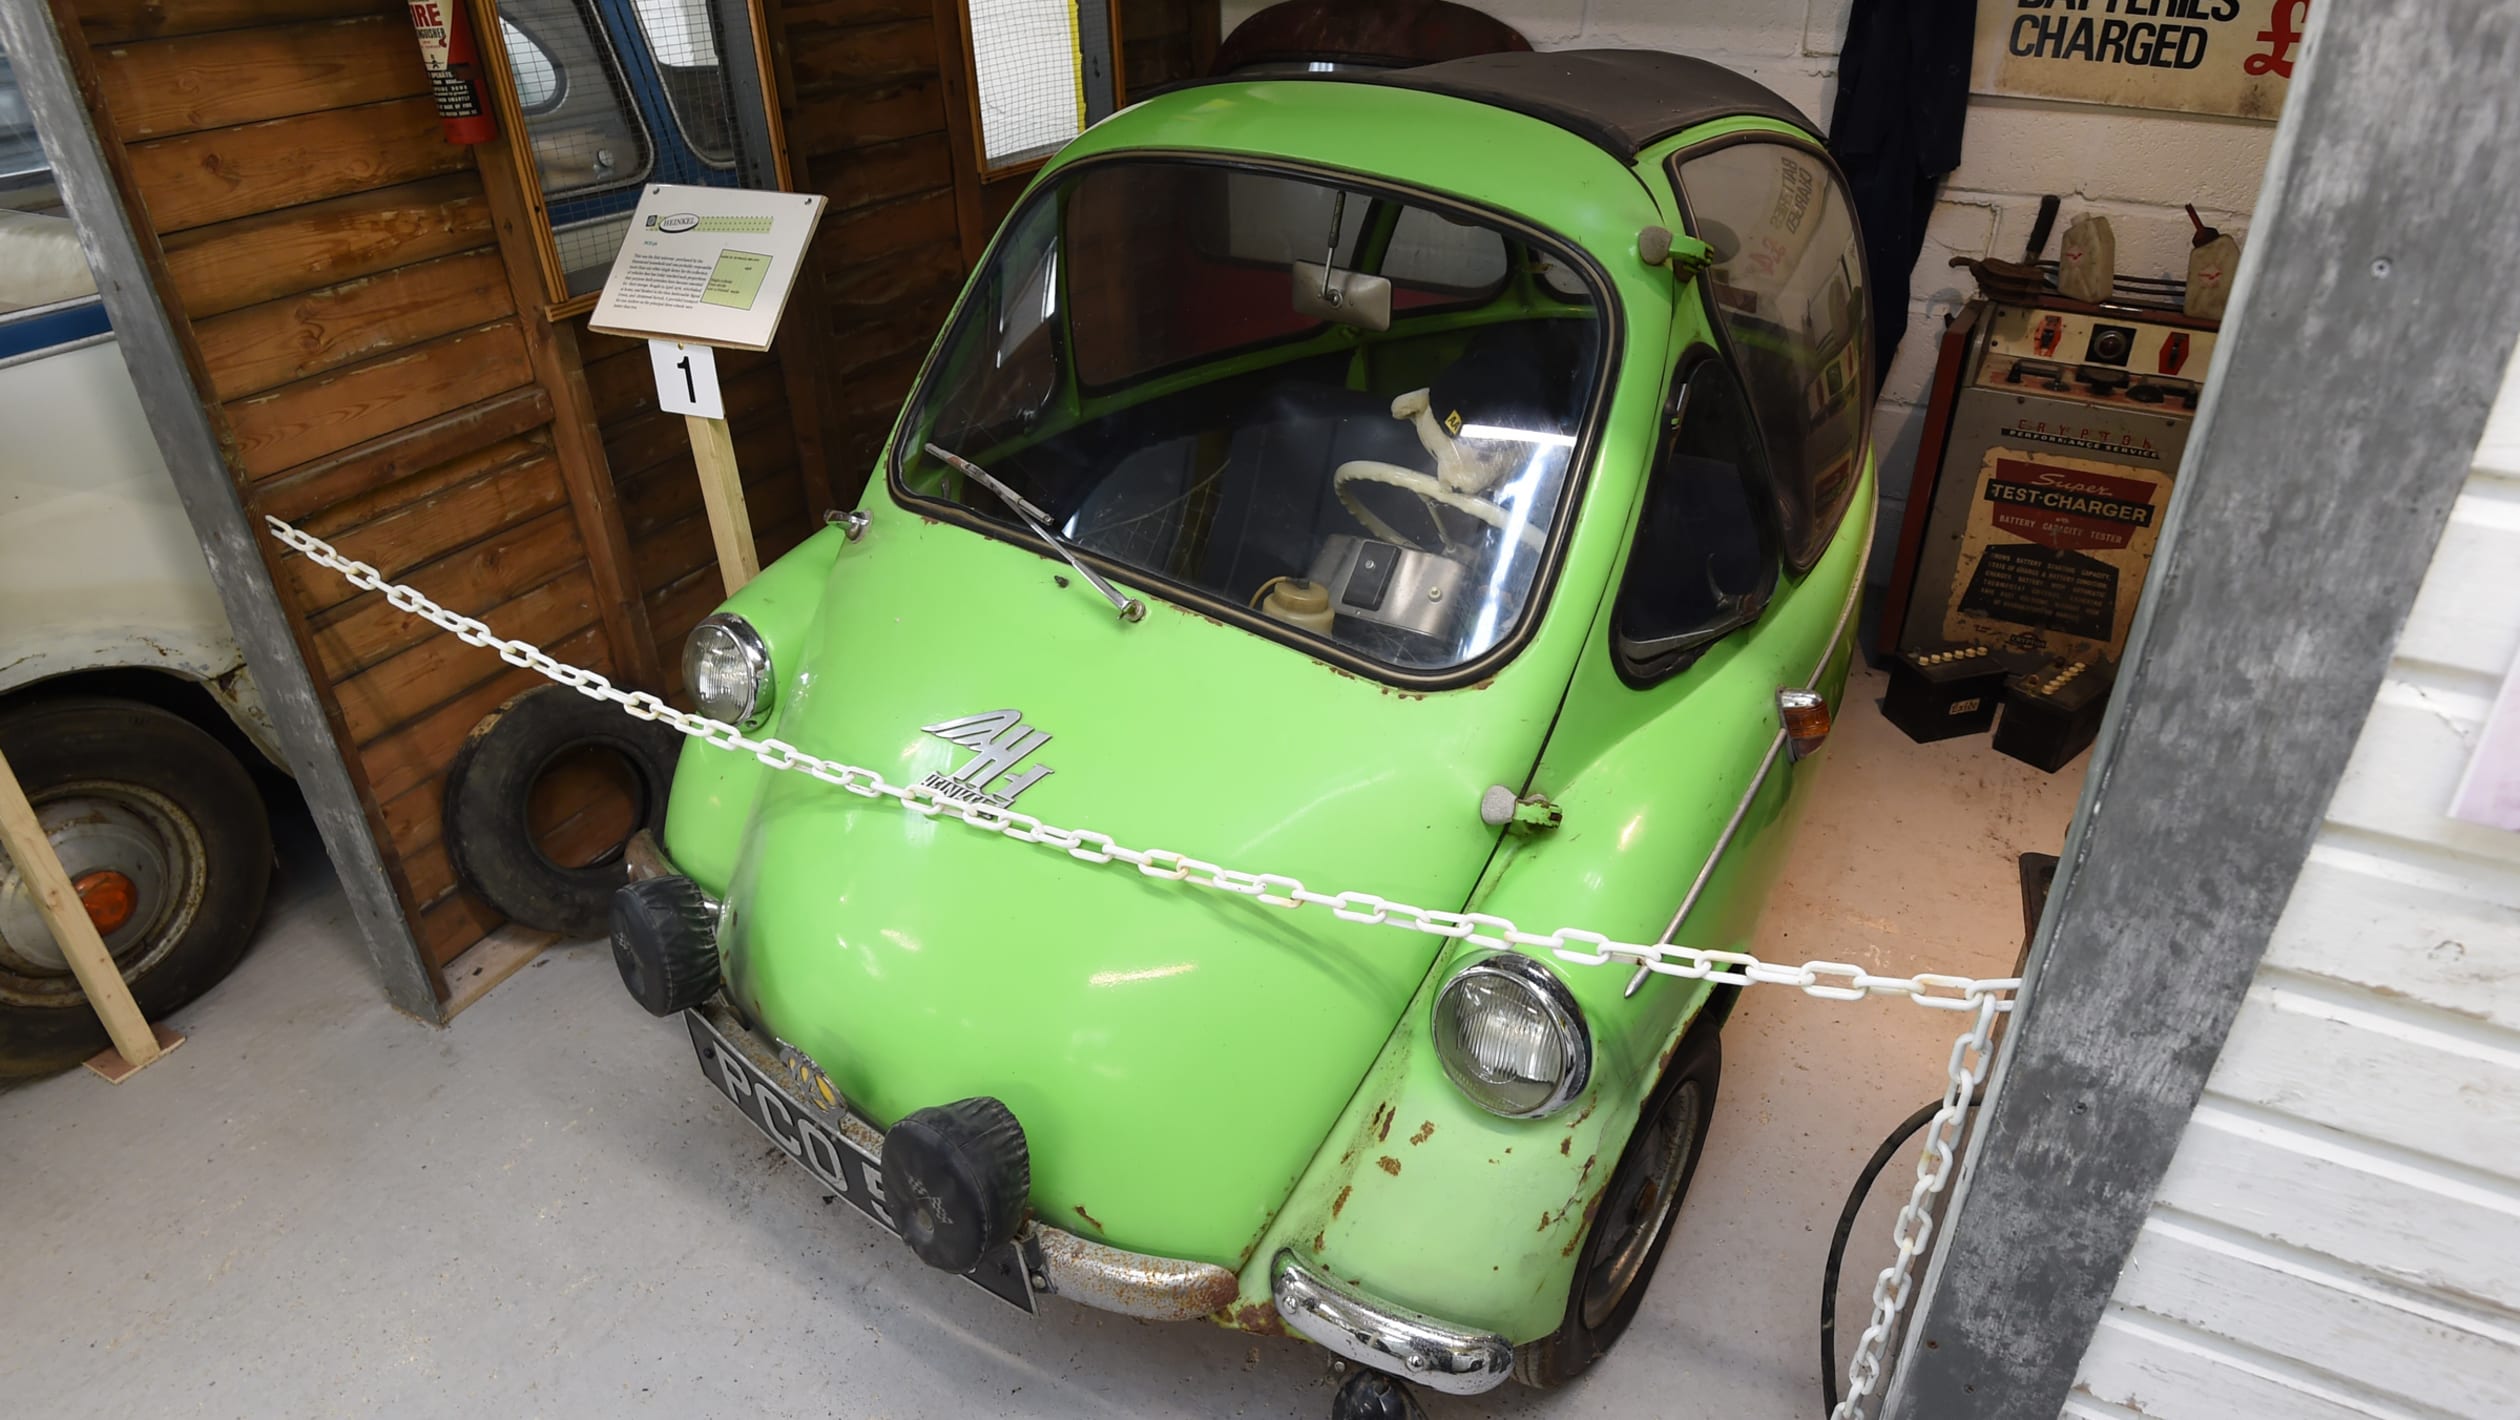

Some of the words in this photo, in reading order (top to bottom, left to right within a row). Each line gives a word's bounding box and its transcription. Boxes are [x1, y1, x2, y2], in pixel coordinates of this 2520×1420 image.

[410, 4, 443, 27] IRE
[2017, 0, 2240, 22] ERIES
[2008, 14, 2209, 70] CHARGED
[663, 217, 696, 228] HEINKEL
[676, 356, 697, 403] 1
[2009, 430, 2101, 449] PERFORMANCE
[2106, 445, 2159, 458] SERVICE
[2031, 473, 2112, 497] Super
[1999, 514, 2036, 528] BATTERY
[2042, 522, 2083, 537] CAPACITY
[2090, 531, 2123, 544] TESTER
[920, 774, 997, 805] HEINK
[713, 1040, 848, 1192] PCO
